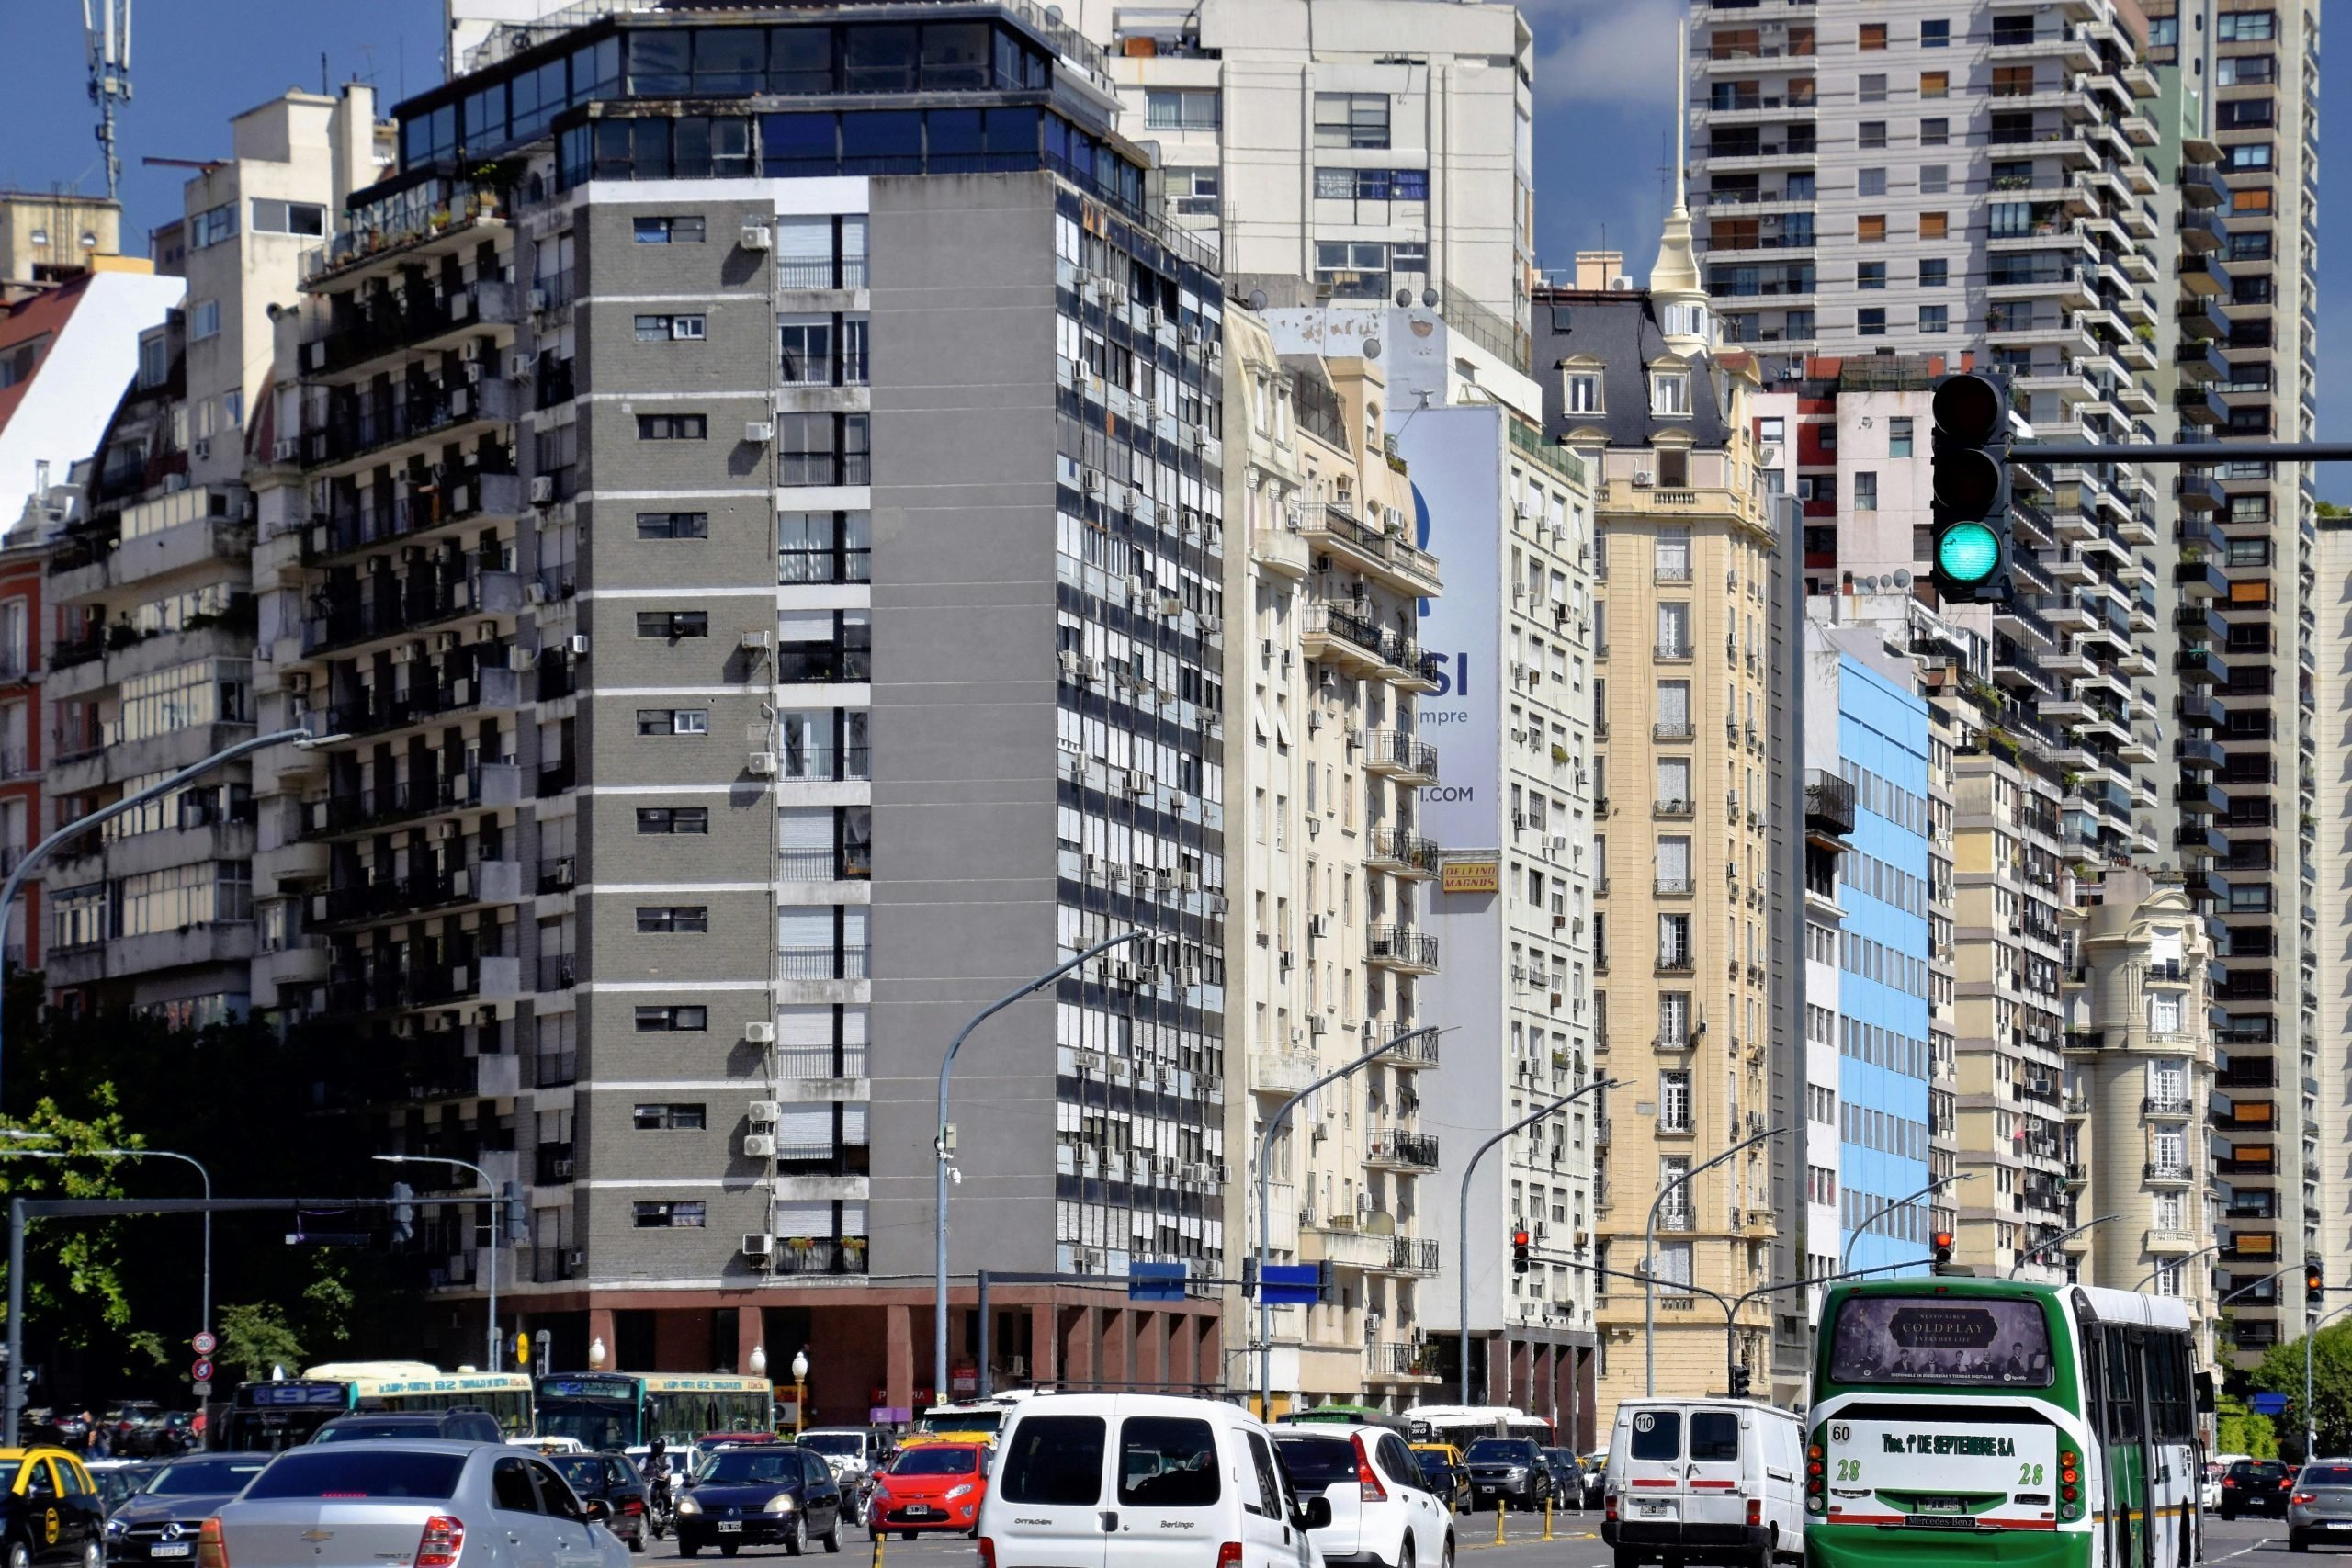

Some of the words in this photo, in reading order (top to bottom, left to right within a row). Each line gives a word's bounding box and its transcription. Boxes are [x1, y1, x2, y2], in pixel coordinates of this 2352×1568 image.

[1445, 866, 1496, 876] DELFINO
[1444, 878, 1495, 888] MAGNUS
[1902, 1323, 1984, 1334] COLDPLAY
[198, 1338, 210, 1348] 20
[273, 1387, 341, 1403] 92
[1637, 1416, 1654, 1429] 110
[1832, 1426, 1850, 1441] 60
[1917, 1435, 1932, 1454] DE
[1933, 1435, 1996, 1457] SEPTIEMBRE
[1837, 1459, 1860, 1481] 28
[2018, 1462, 2044, 1485] 28
[1160, 1520, 1195, 1529] Berlingo
[1907, 1517, 1973, 1527] Mercedes-Benz
